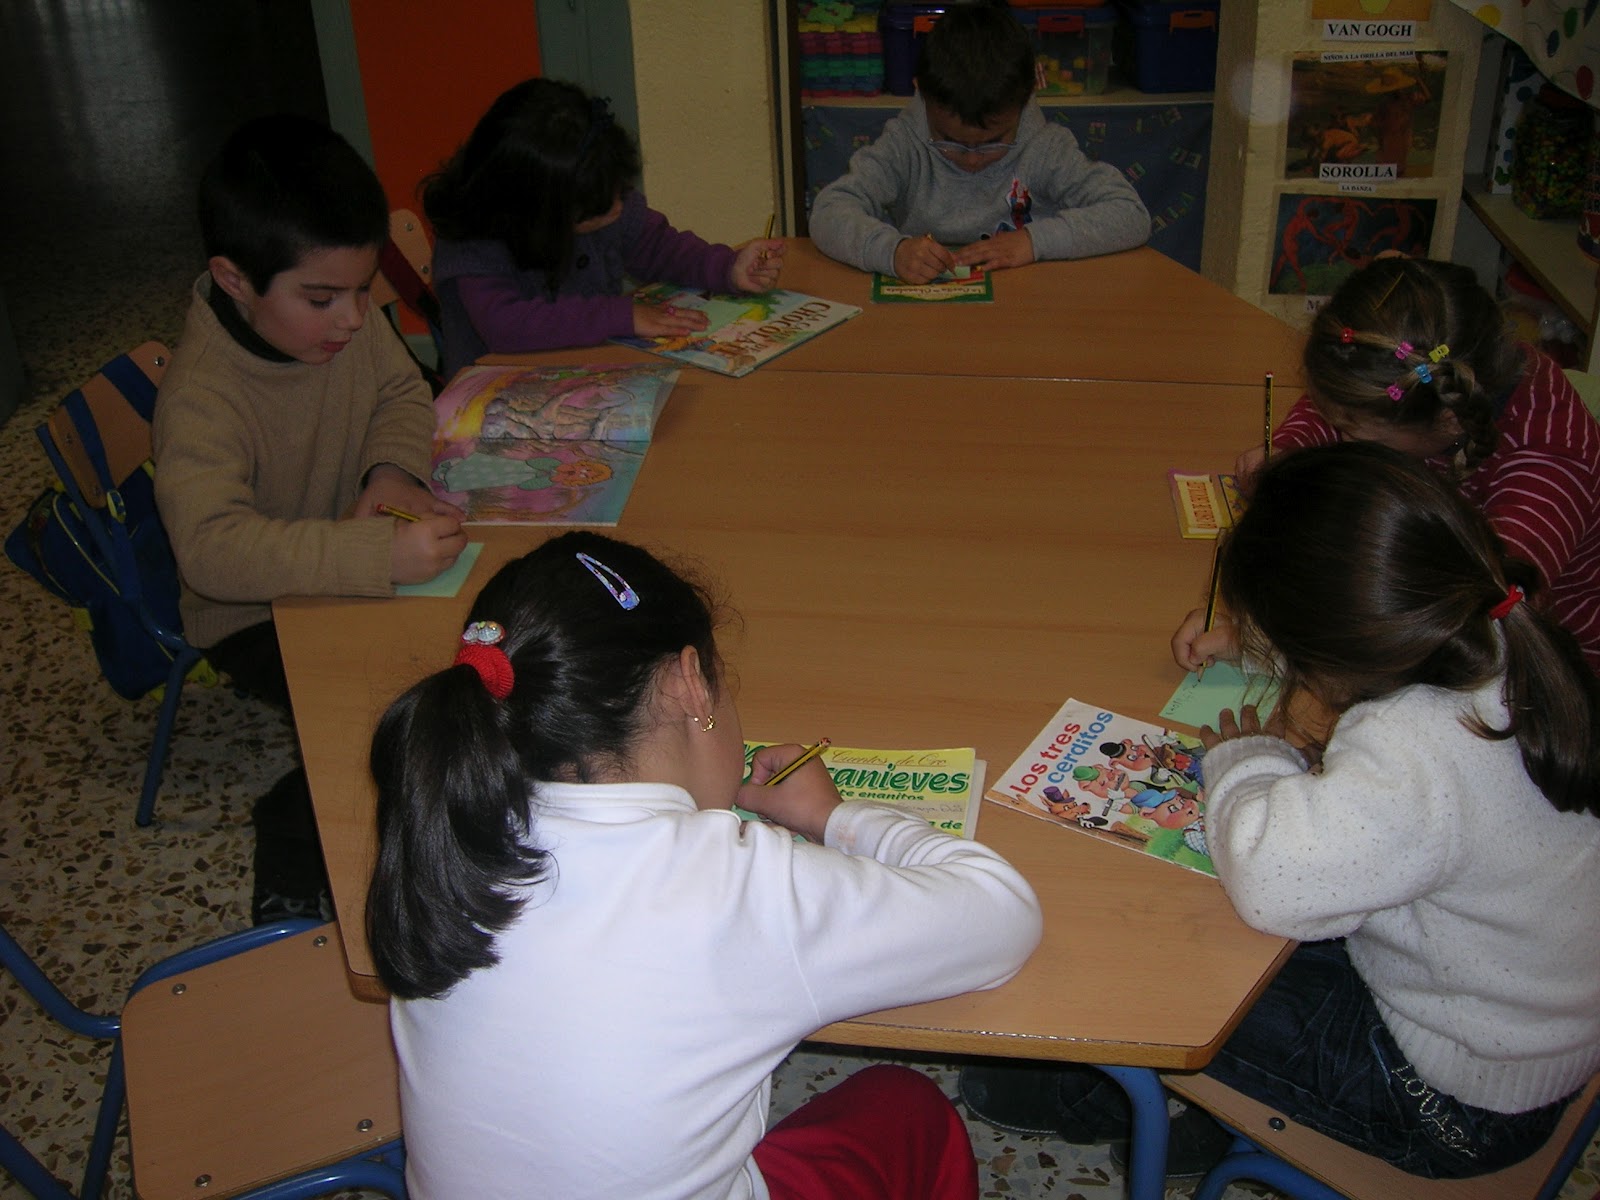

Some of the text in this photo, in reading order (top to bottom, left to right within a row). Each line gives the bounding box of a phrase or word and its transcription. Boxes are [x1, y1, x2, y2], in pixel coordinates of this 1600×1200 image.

[1327, 23, 1413, 37] VAN GOGH
[1323, 53, 1344, 61] NIÑOS
[1321, 165, 1394, 179] SOROLLA
[715, 302, 831, 357] CHOCOLATE
[1047, 711, 1114, 785] cerditos
[831, 751, 947, 767] Cuentos de Oro
[1009, 722, 1081, 795] Los tres
[858, 792, 925, 801] enanitos
[939, 819, 963, 830] de
